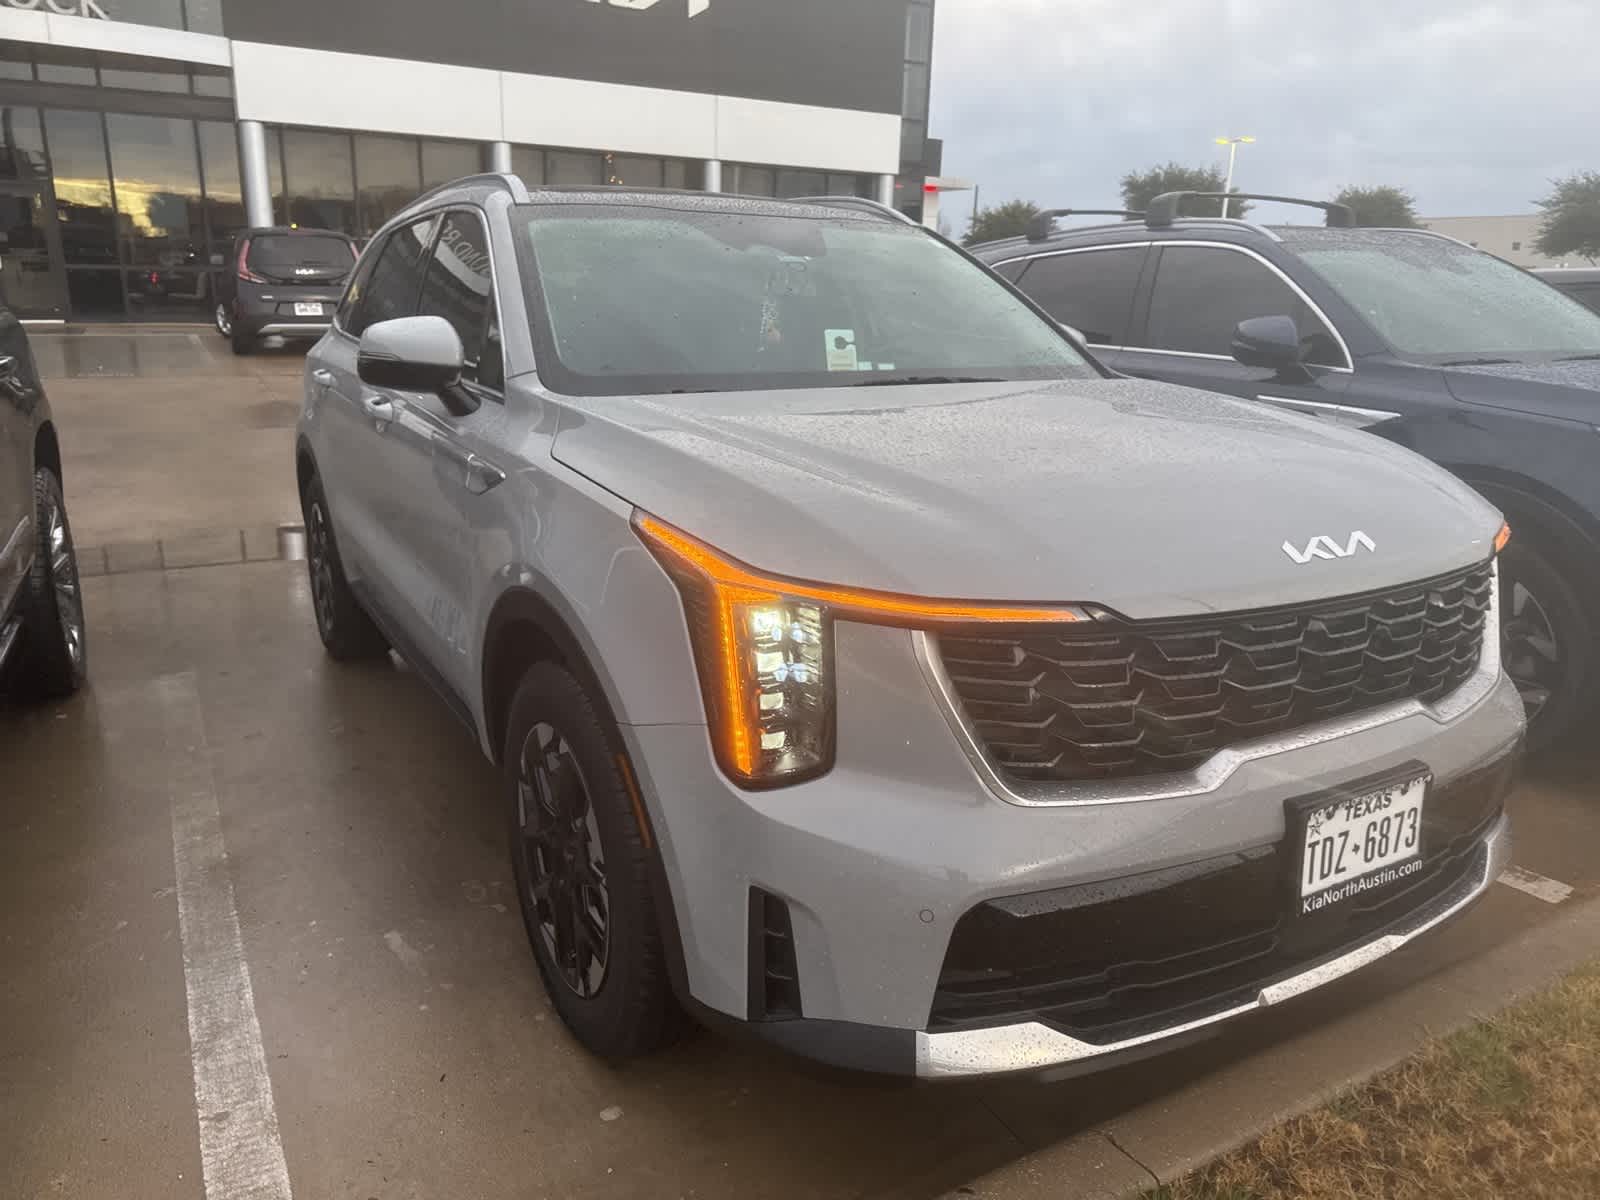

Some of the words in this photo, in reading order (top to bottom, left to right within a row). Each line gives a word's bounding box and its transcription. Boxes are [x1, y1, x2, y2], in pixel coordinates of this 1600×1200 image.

[1281, 529, 1377, 564] KIA
[1344, 792, 1393, 822] TEXAS
[1307, 829, 1350, 885] TDZ
[1363, 806, 1419, 864] 6873
[1302, 859, 1423, 914] KiaNorthAustin.com
